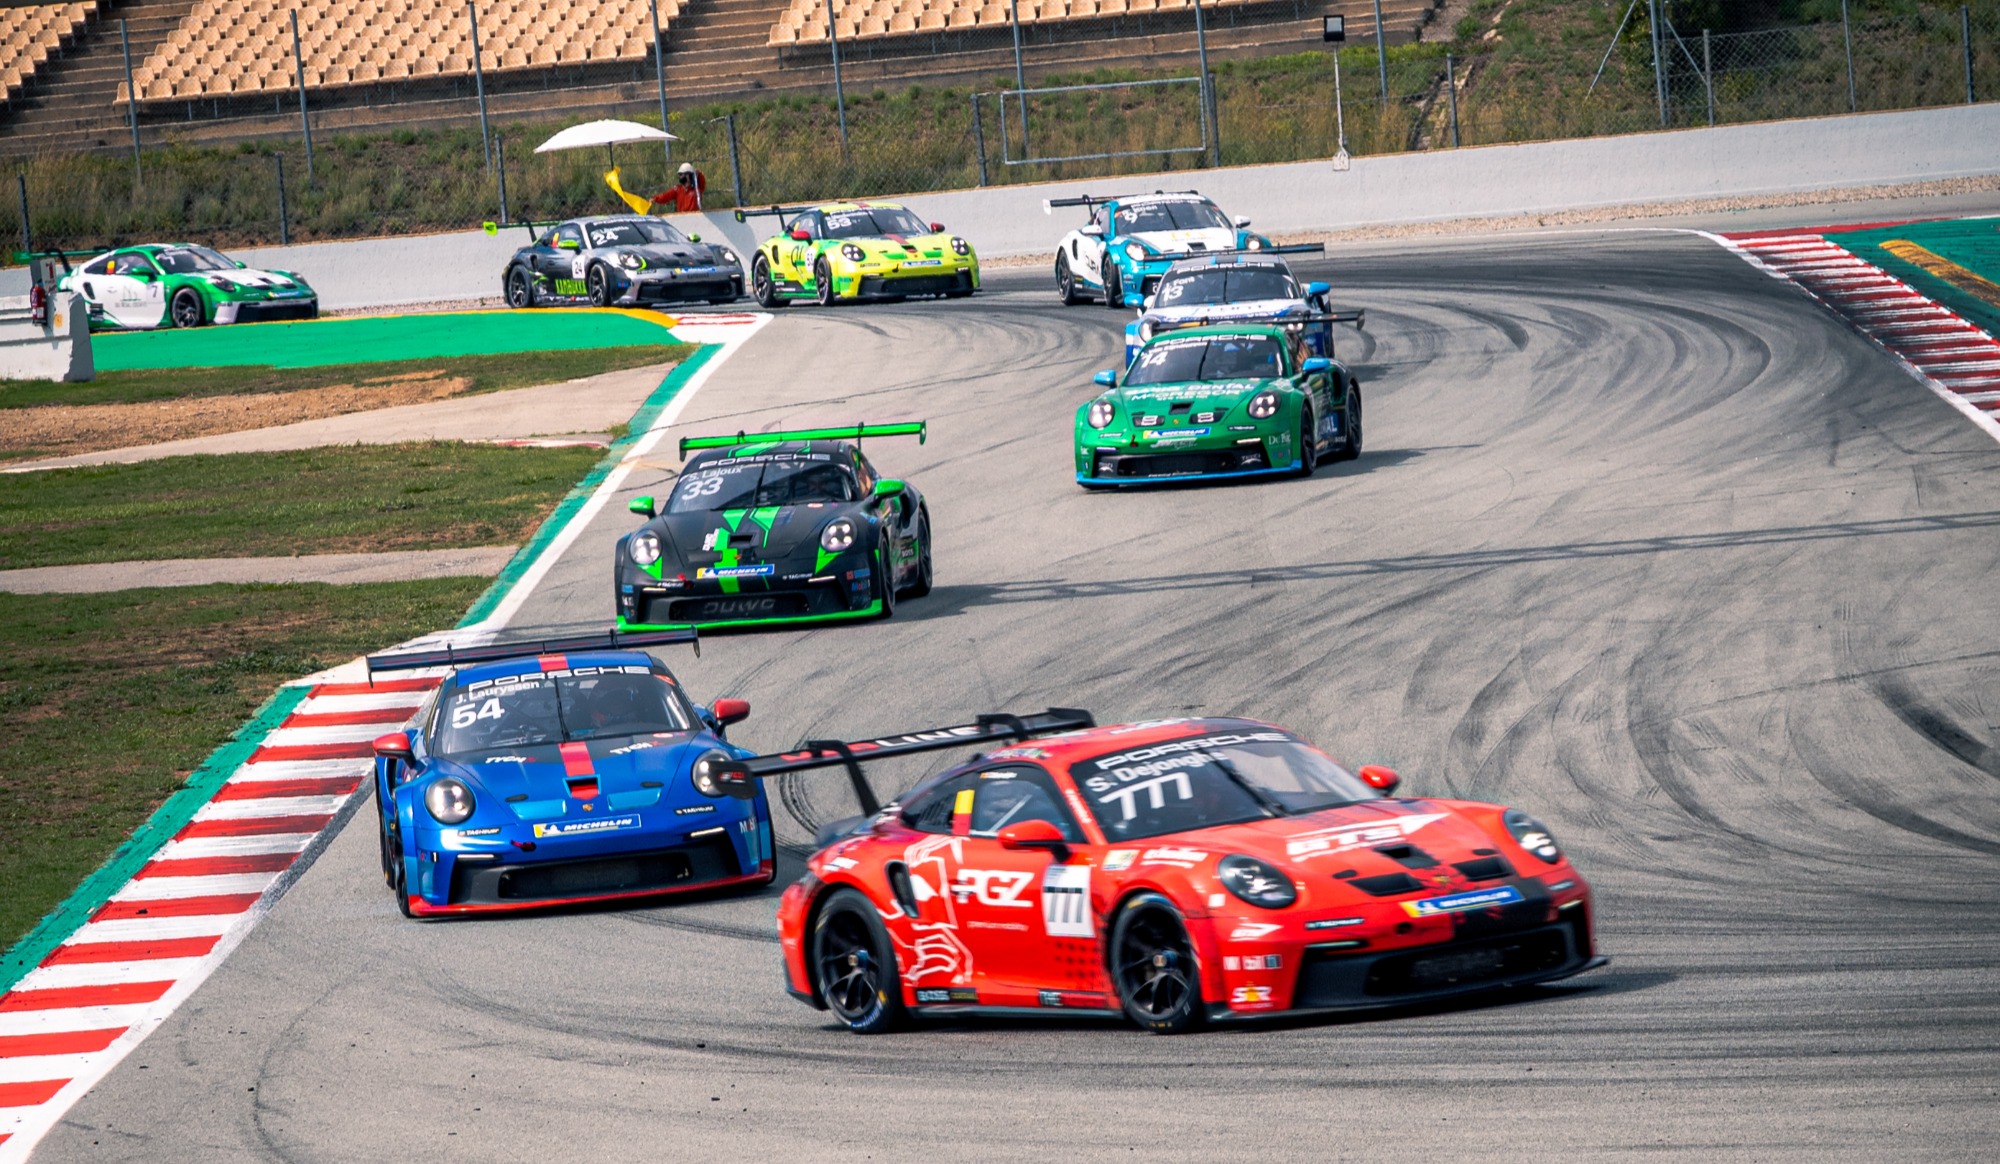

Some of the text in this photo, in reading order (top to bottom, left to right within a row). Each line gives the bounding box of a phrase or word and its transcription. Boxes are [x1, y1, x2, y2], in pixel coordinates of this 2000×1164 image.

[827, 217, 852, 230] 53
[1123, 213, 1138, 224] 9
[593, 231, 619, 245] 24
[1176, 262, 1275, 274] PORSCHE
[151, 285, 159, 298] 7
[1161, 284, 1184, 301] 13
[1153, 334, 1268, 348] PORSCHE
[1140, 350, 1169, 369] 14
[698, 453, 831, 470] PORSCHE
[688, 463, 743, 481] S. Lajoux
[681, 477, 723, 500] 33
[717, 566, 769, 577] MICHELIN
[468, 665, 651, 693] PORSCHE
[456, 680, 540, 705] J. Lauryssen
[451, 697, 506, 730] 54
[1095, 732, 1292, 771] PORSCHE
[1085, 775, 1118, 793] S.
[1098, 771, 1194, 821] 777
[563, 818, 633, 832] MICHELIN
